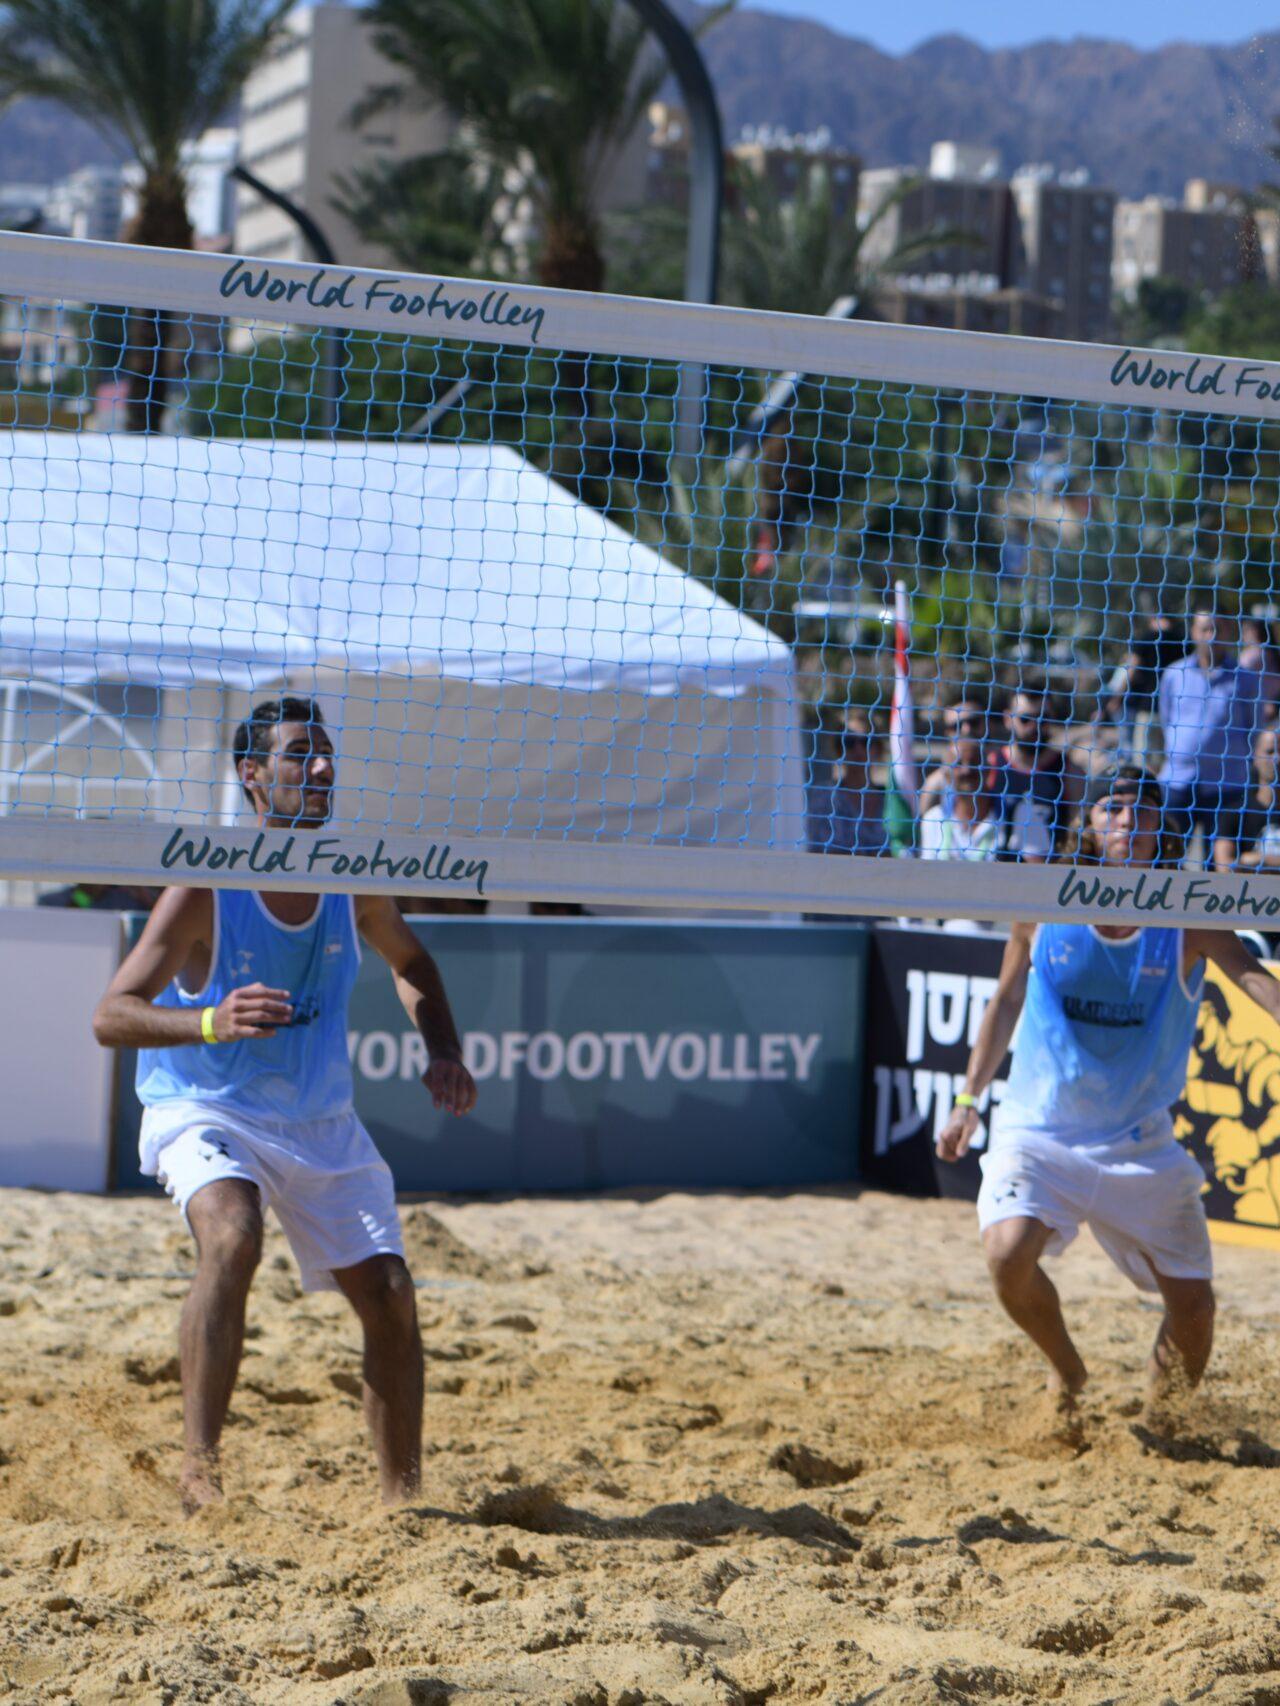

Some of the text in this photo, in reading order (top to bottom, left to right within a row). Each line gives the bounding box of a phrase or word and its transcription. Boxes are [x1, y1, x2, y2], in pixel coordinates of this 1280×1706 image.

[219, 258, 546, 344] World Footvolley
[1111, 349, 1227, 396] World
[160, 827, 490, 895] World Footvolley
[1057, 868, 1175, 911] World
[347, 1030, 822, 1082] ORDFOOTVOLLEY
